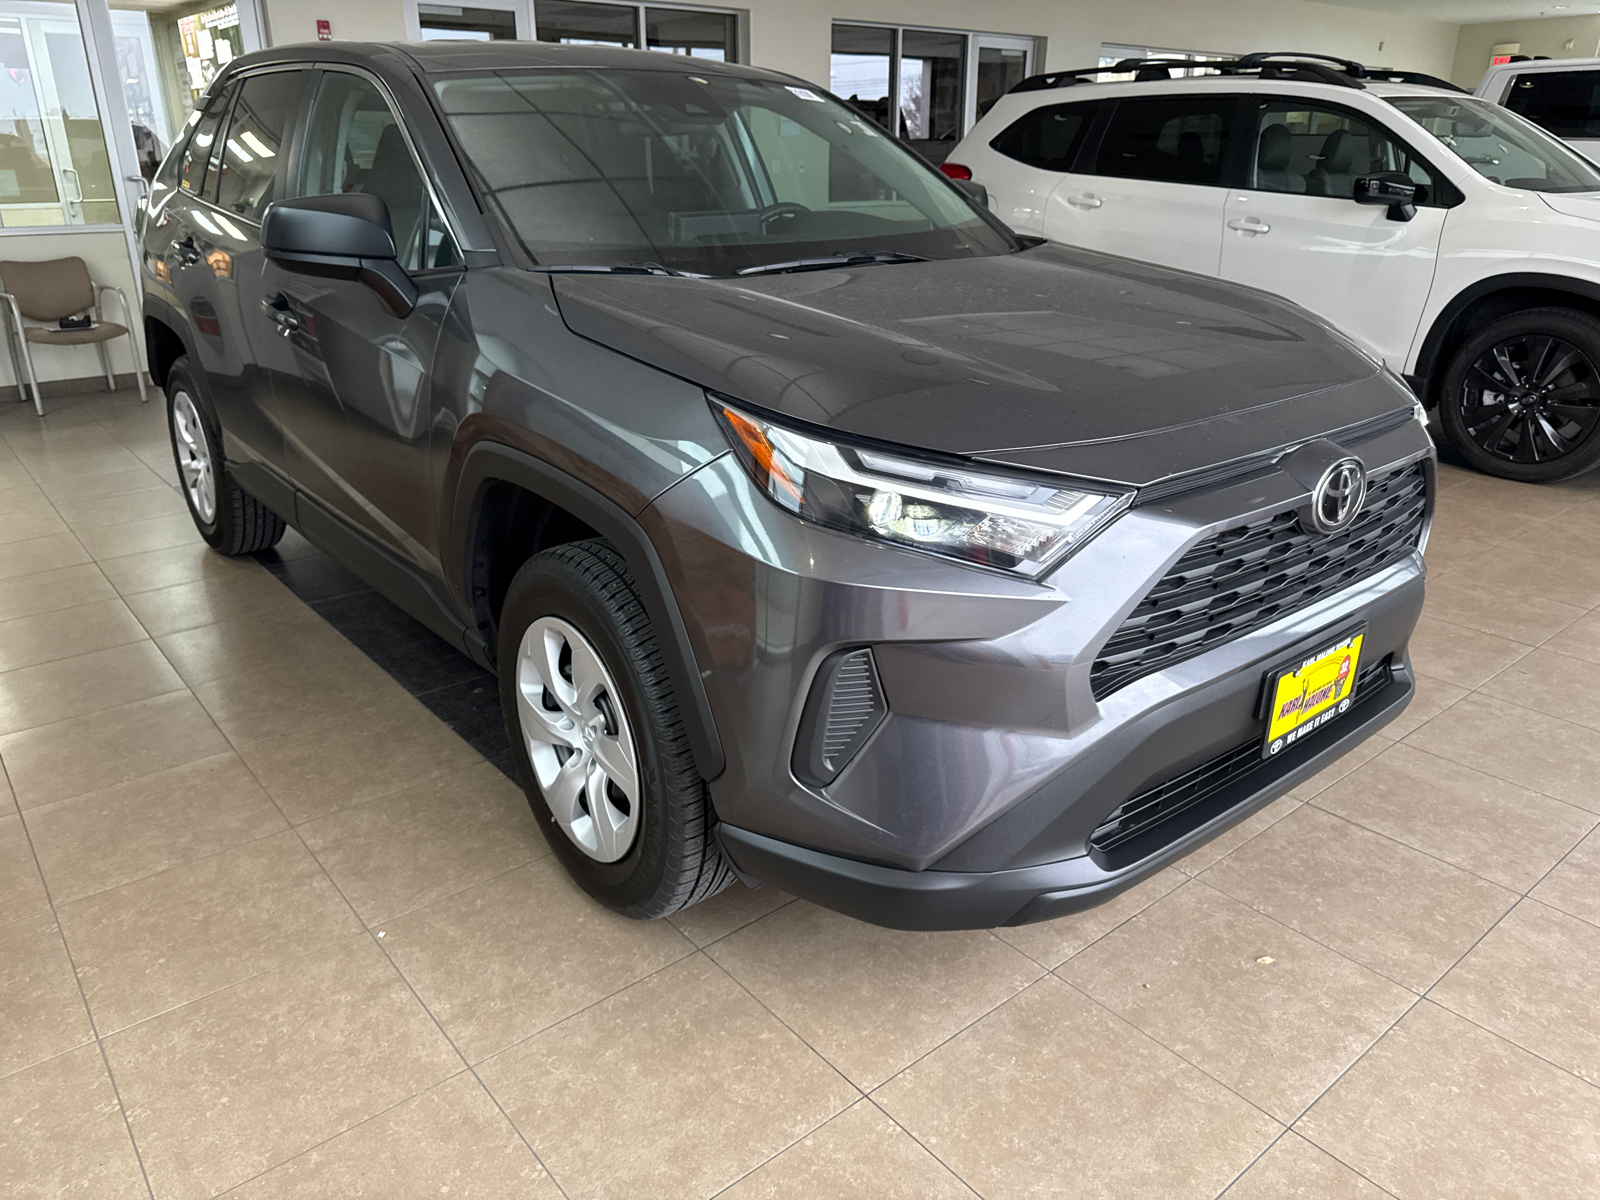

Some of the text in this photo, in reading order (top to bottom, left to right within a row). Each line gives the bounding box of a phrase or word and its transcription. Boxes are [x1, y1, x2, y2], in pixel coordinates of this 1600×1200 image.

[1287, 707, 1335, 744] WE MAKE IT EASY
